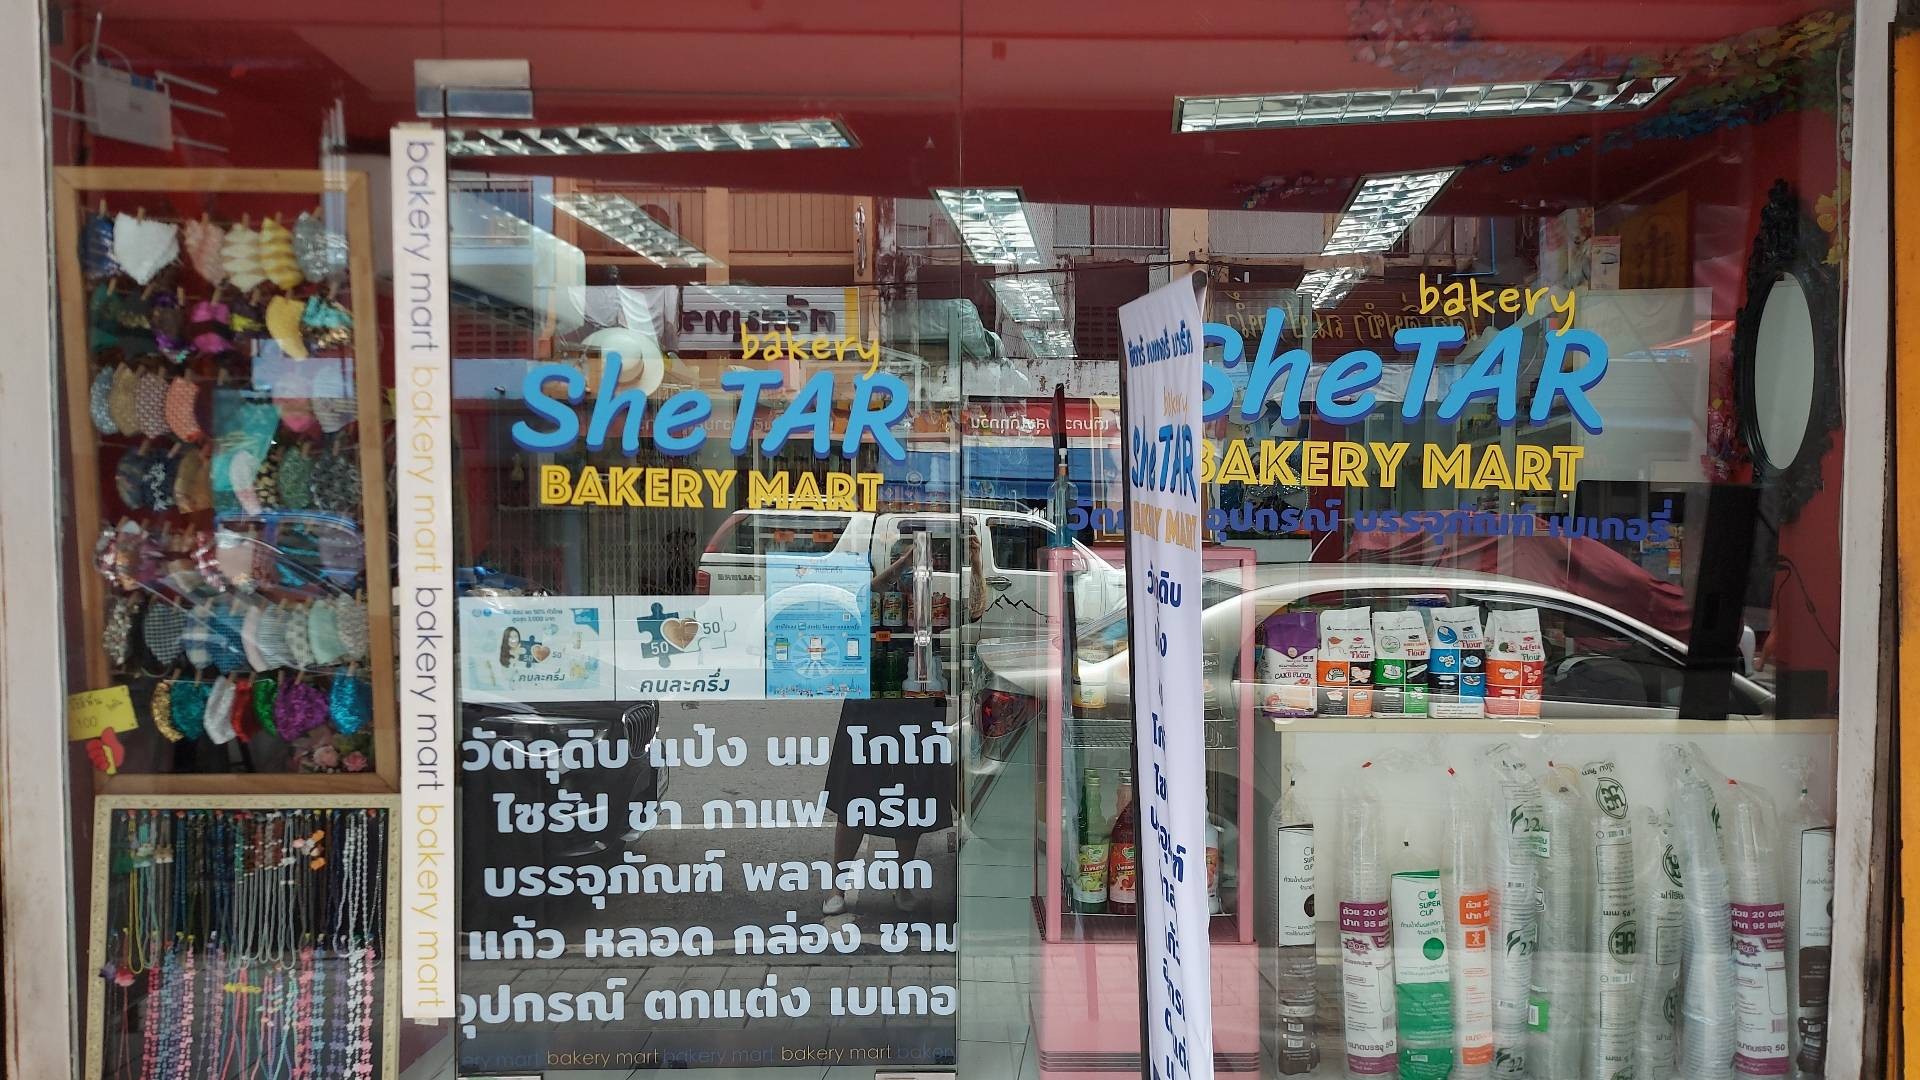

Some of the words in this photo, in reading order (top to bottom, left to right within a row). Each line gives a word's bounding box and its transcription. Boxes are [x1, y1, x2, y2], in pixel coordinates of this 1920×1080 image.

[403, 140, 437, 262] bakery
[410, 272, 438, 351] mart
[1419, 273, 1575, 336] bakery
[741, 322, 879, 380] bakery
[1201, 307, 1609, 433] SheTAR
[407, 367, 441, 485] bakery
[511, 351, 909, 465] SheTAR
[1131, 415, 1197, 504] SheTAR
[1422, 443, 1584, 493] MART
[540, 464, 737, 509] BAKERY
[747, 470, 884, 512] MART
[414, 495, 442, 573] mart
[1206, 500, 1341, 542] อุปกรณ์
[1355, 501, 1537, 545] บรรจุภัณฑ์
[1551, 499, 1672, 542] เบเกอรี่
[410, 586, 443, 703] bakery
[651, 642, 669, 655] 50
[703, 621, 720, 634] 50
[518, 668, 565, 683] คนละครึ่ง
[640, 668, 730, 693] คนละครึ่ง
[1275, 672, 1291, 680] CAKE
[416, 714, 445, 791] mart
[462, 727, 629, 784] วัตถุดิบ
[649, 723, 747, 768] แป้ง
[768, 734, 830, 767] นม
[846, 721, 954, 765] โกโก้
[493, 789, 608, 833] ไซรัป
[628, 798, 682, 829] ชา
[703, 791, 829, 829] กาแฟ
[846, 783, 937, 828] ครีม
[412, 804, 445, 921] bakery
[484, 849, 726, 910] บรรจุภัณฑ์
[743, 850, 933, 891] พลาสติก
[1363, 909, 1376, 917] 20
[1364, 920, 1377, 928] 95
[1419, 900, 1441, 909] SUPER
[1420, 909, 1434, 917] CUP
[1752, 911, 1765, 919] 20
[1752, 922, 1765, 930] 95
[468, 915, 566, 961] แก้ว
[585, 926, 714, 958] หลอด
[734, 911, 861, 955] กล่อง
[416, 930, 445, 1007] mart
[459, 978, 626, 1039] อุปกรณ์
[644, 974, 811, 1019] ตกแต่ง
[547, 1047, 610, 1068] bakery
[616, 1048, 659, 1064] mart
[781, 1044, 844, 1064] bakery
[850, 1045, 891, 1061] mart
